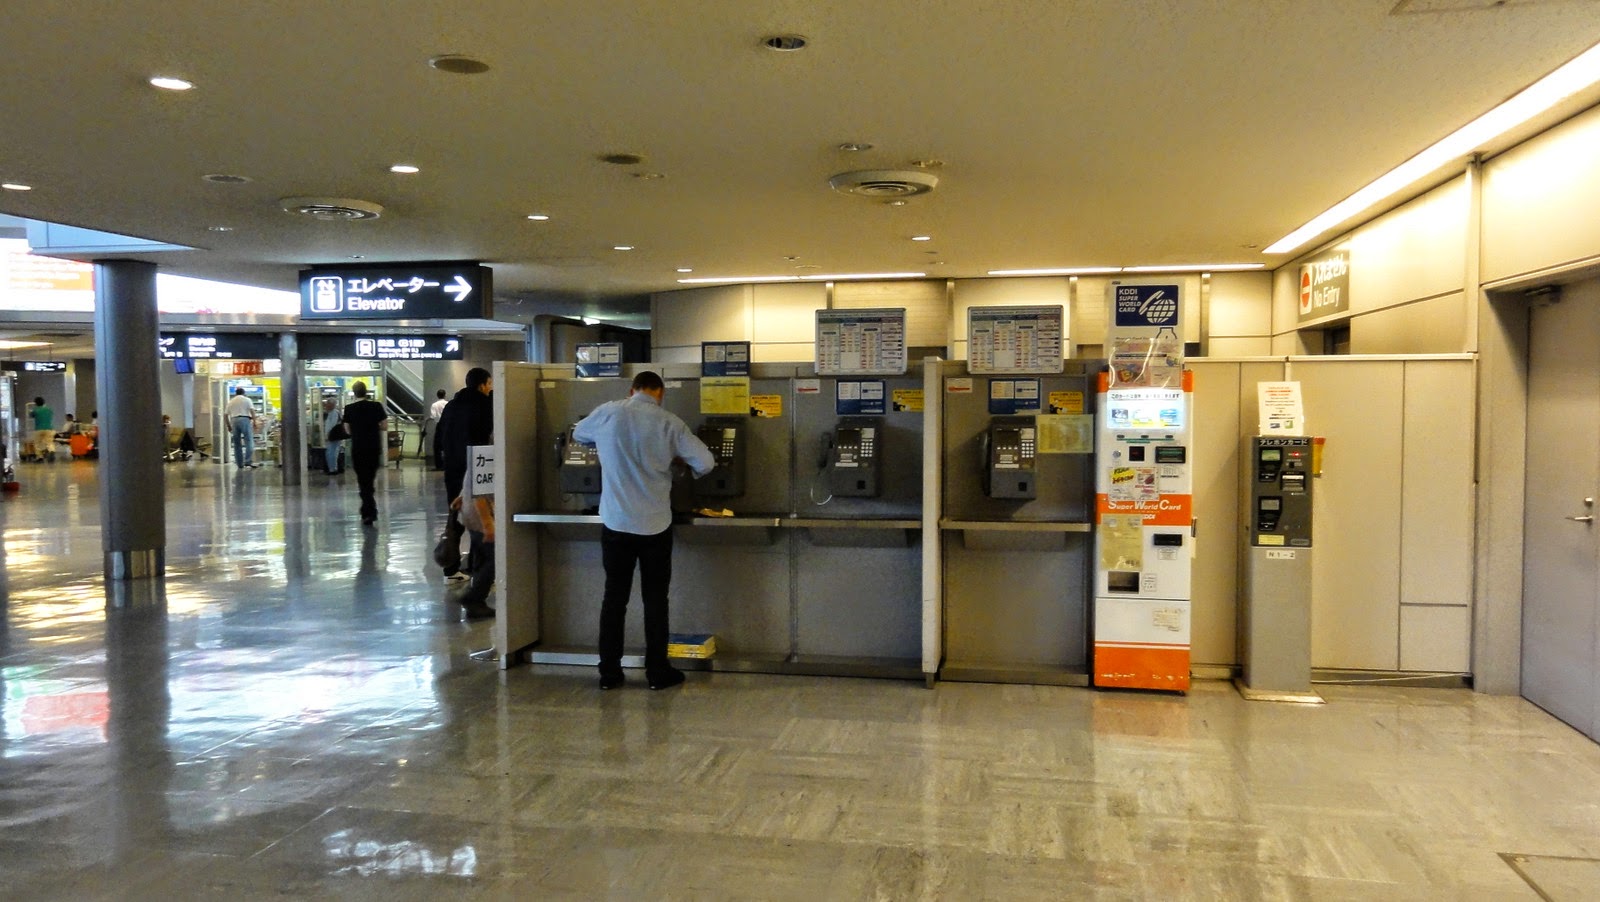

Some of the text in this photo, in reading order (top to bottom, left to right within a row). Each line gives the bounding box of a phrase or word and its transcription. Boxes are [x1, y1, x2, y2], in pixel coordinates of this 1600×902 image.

[347, 276, 440, 293] エレベーター
[348, 296, 405, 310] Elevator
[1313, 286, 1340, 308] No Entry
[476, 454, 494, 467] カー
[476, 473, 494, 484] CAR
[1108, 499, 1182, 511] Super World Card
